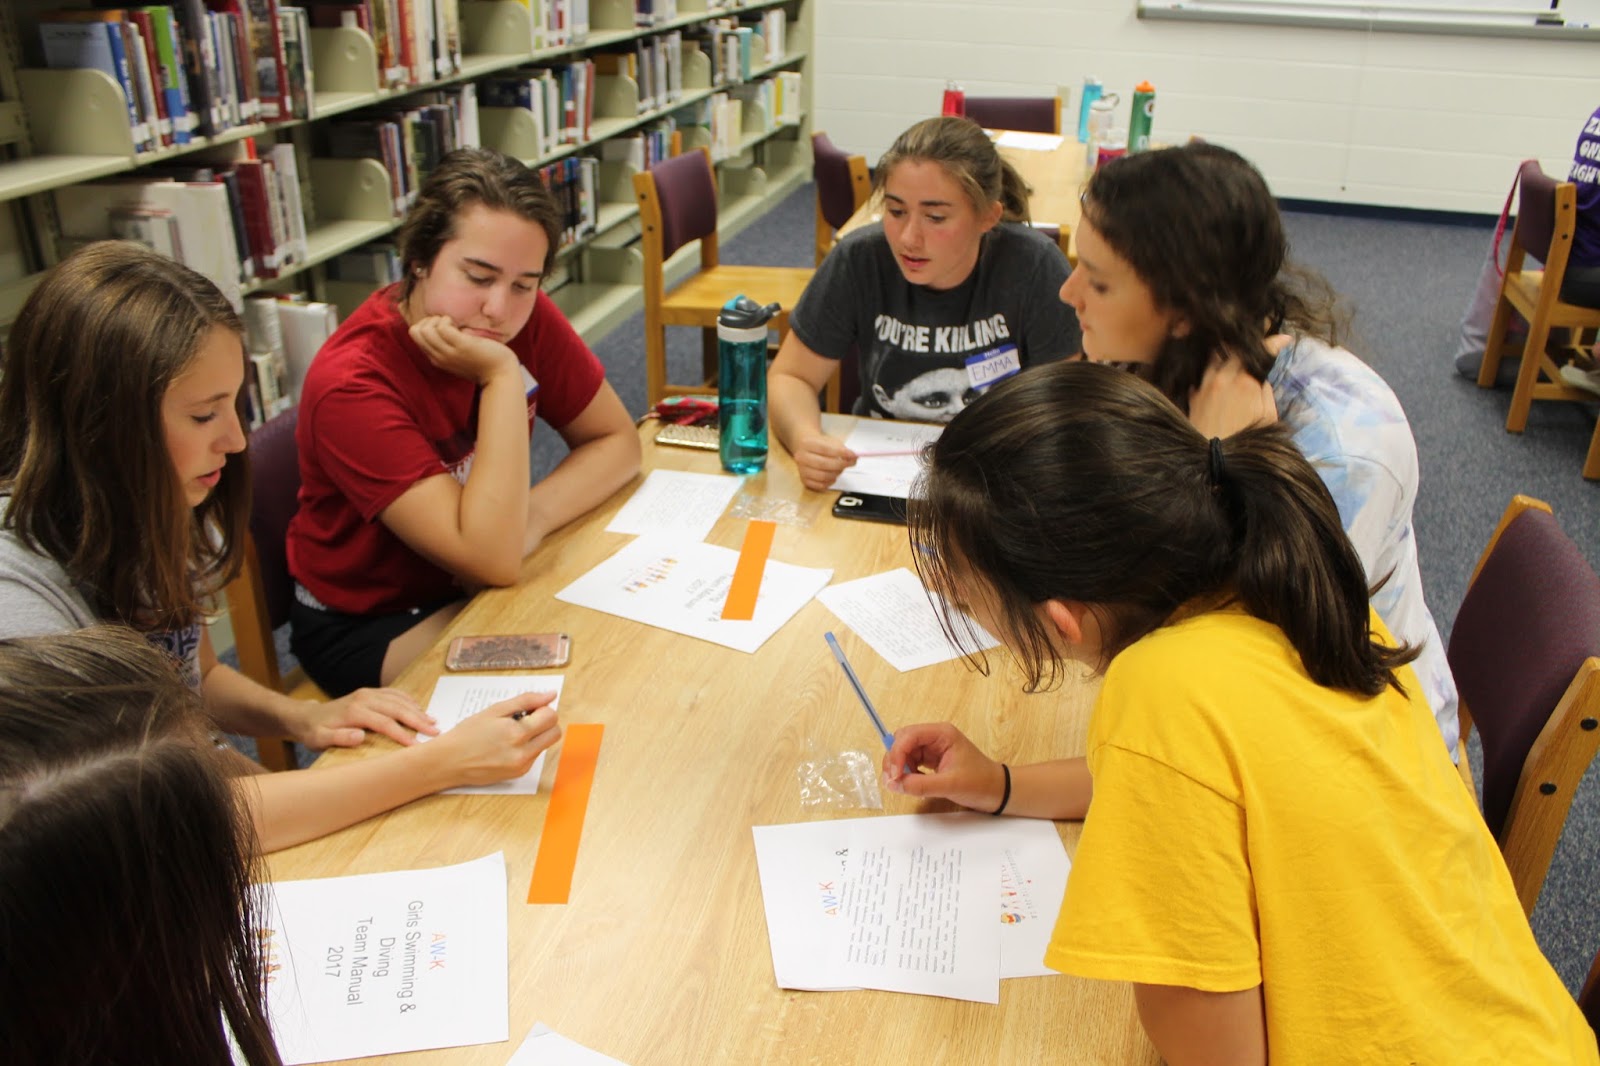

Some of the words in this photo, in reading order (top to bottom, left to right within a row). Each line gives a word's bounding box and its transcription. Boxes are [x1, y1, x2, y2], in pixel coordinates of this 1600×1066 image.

[1579, 140, 1600, 162] ON
[1570, 161, 1600, 185] IGH
[971, 355, 1013, 382] EMMA
[407, 900, 424, 928] Girls
[819, 881, 838, 916] AW-K
[354, 916, 373, 952] Team
[430, 932, 446, 970] AW-K
[325, 945, 345, 978] 2017
[372, 937, 396, 978] Diving
[396, 931, 422, 999] Swimming
[346, 956, 369, 1005] Manual
[400, 1003, 417, 1014] &
